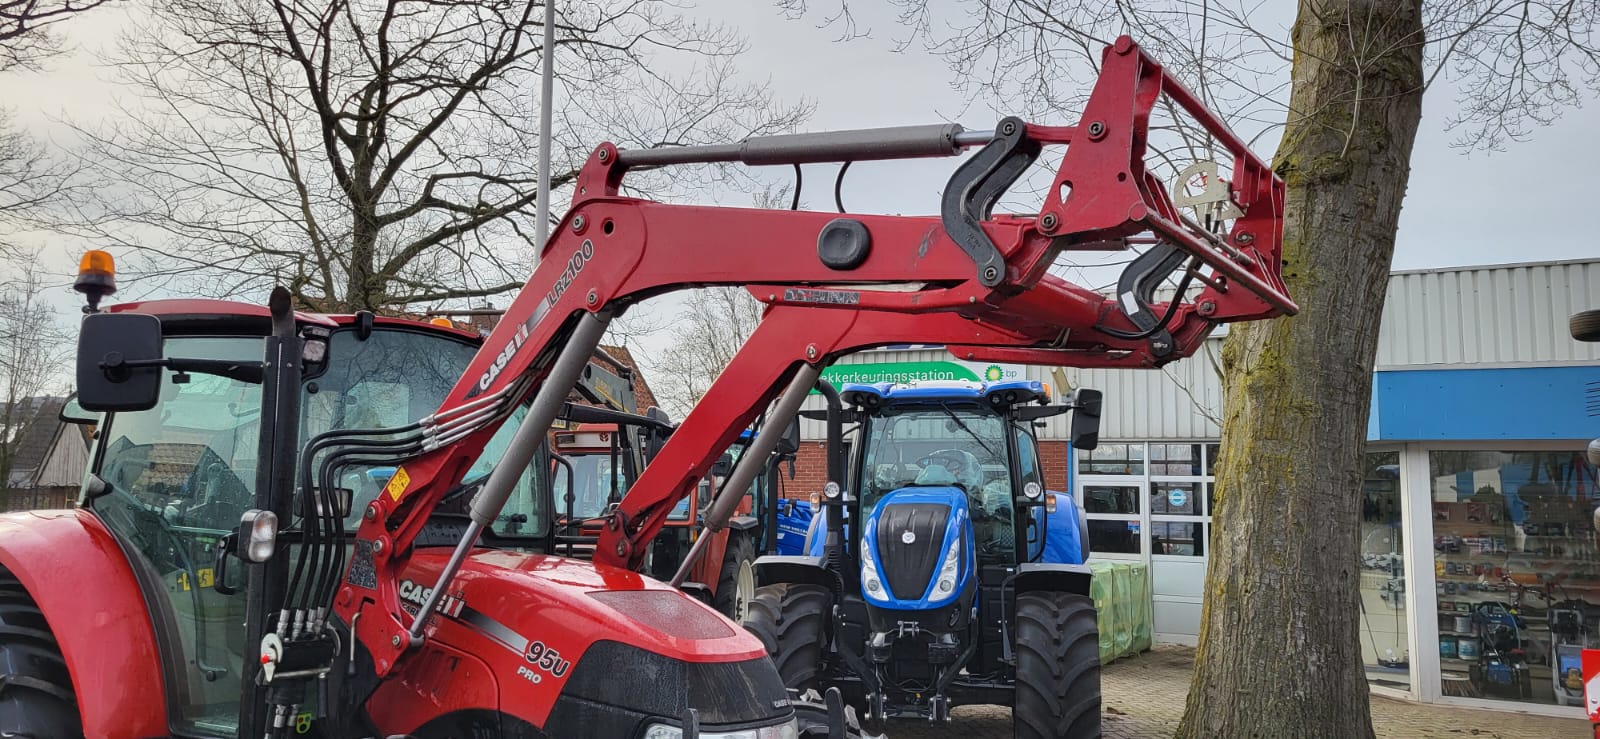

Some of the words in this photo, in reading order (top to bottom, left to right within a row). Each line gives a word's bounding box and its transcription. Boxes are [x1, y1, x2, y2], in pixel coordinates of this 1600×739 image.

[548, 239, 594, 308] LRZ100
[479, 341, 517, 391] CASE
[1005, 368, 1018, 380] bp
[516, 665, 542, 684] PRO
[526, 641, 570, 678] 95U
